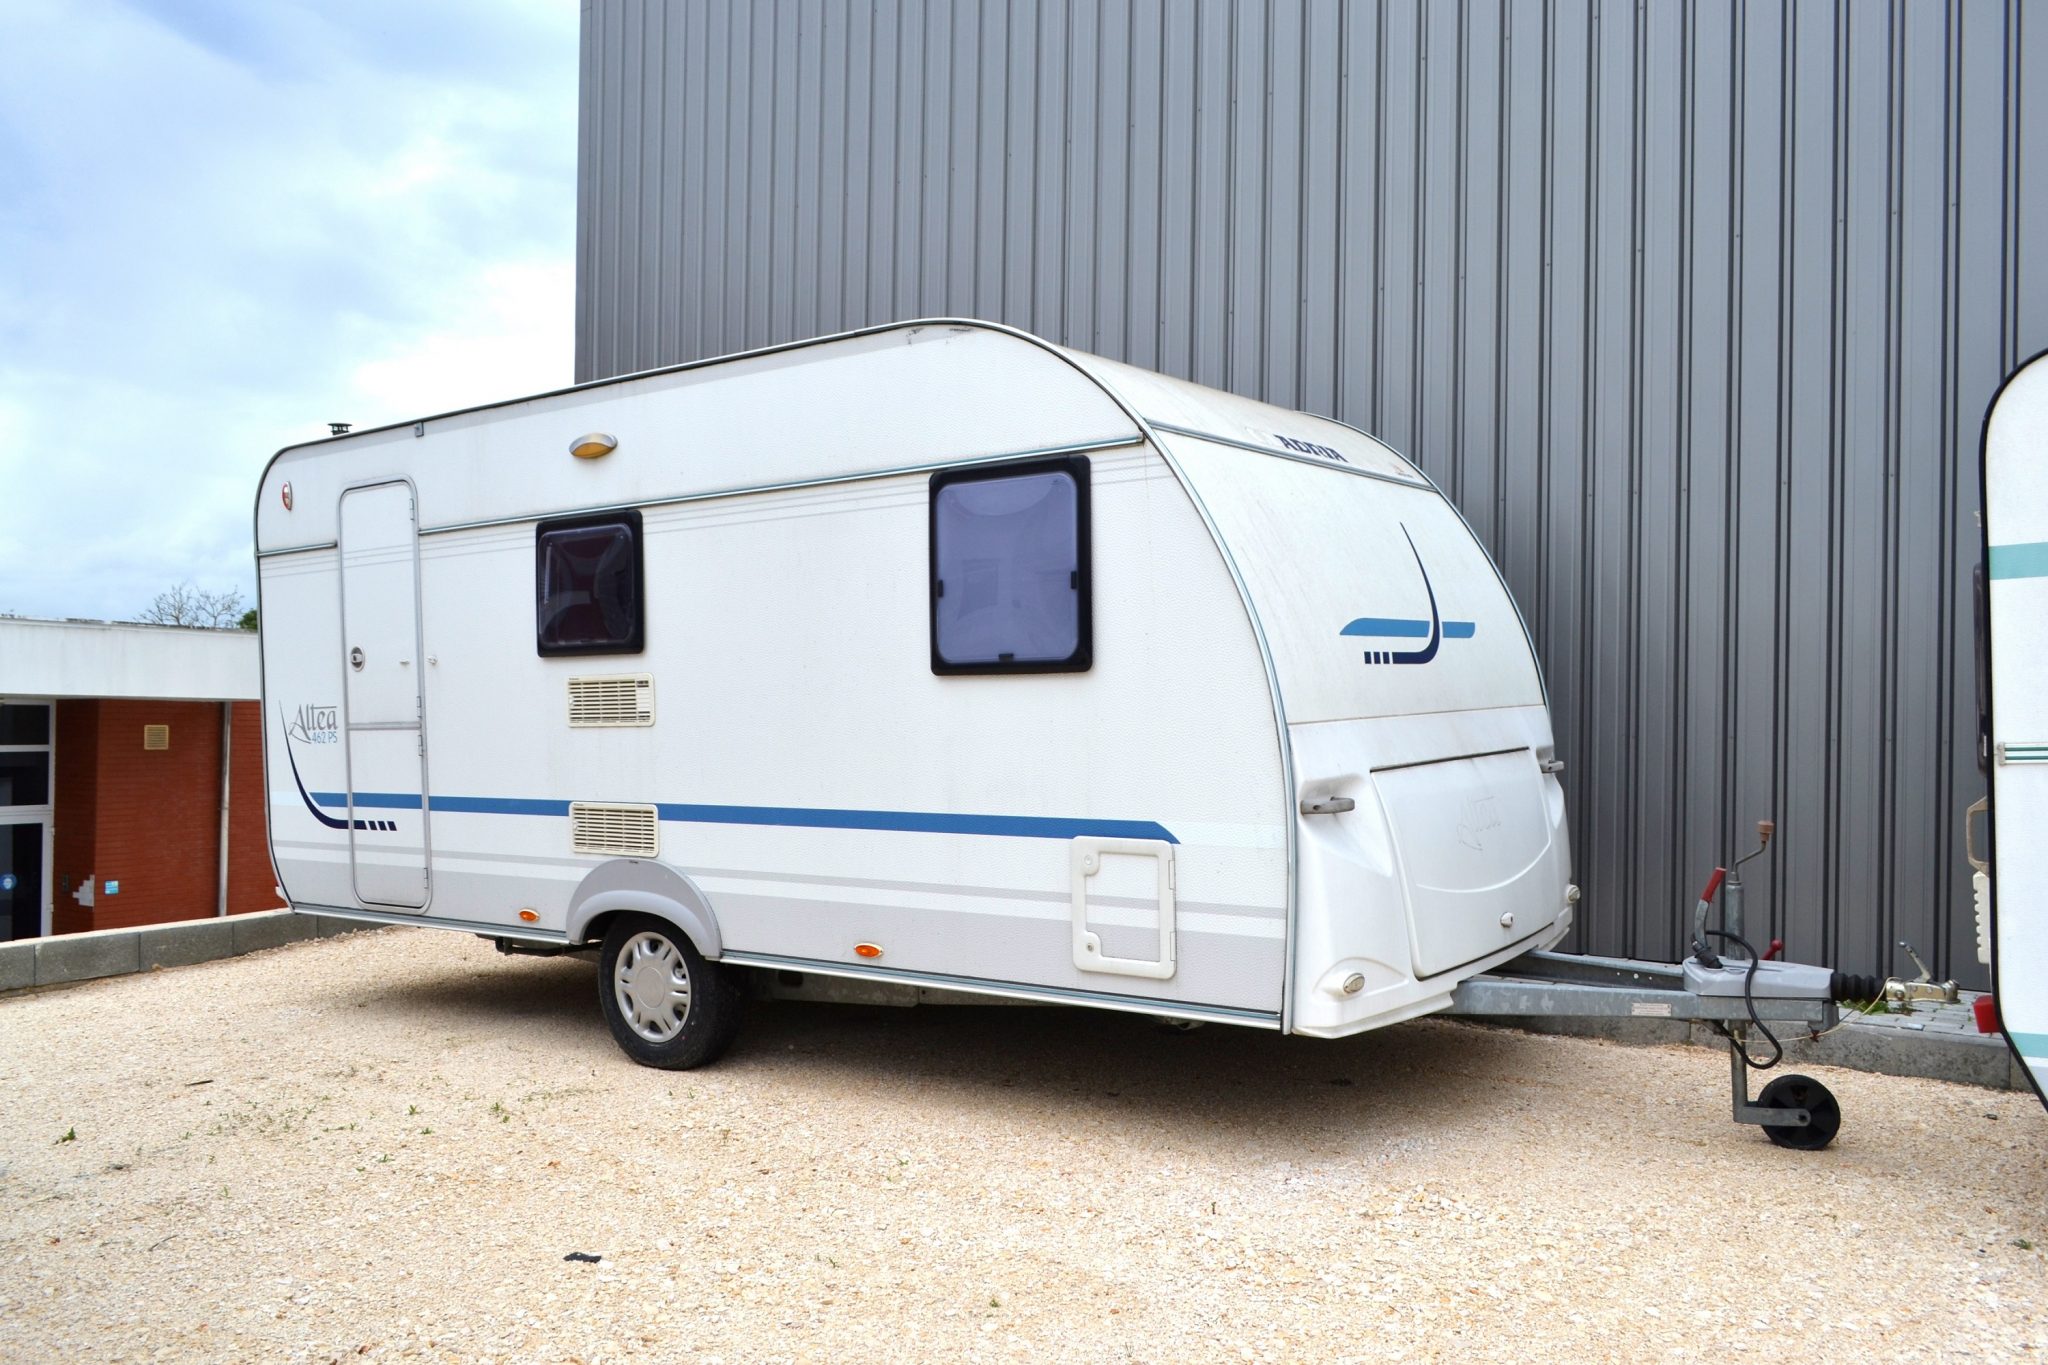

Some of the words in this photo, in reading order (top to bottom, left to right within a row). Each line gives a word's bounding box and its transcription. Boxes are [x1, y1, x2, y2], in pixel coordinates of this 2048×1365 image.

[1273, 434, 1348, 462] ADRIA
[288, 703, 338, 744] Altea
[311, 731, 327, 743] 462
[328, 731, 338, 743] PS
